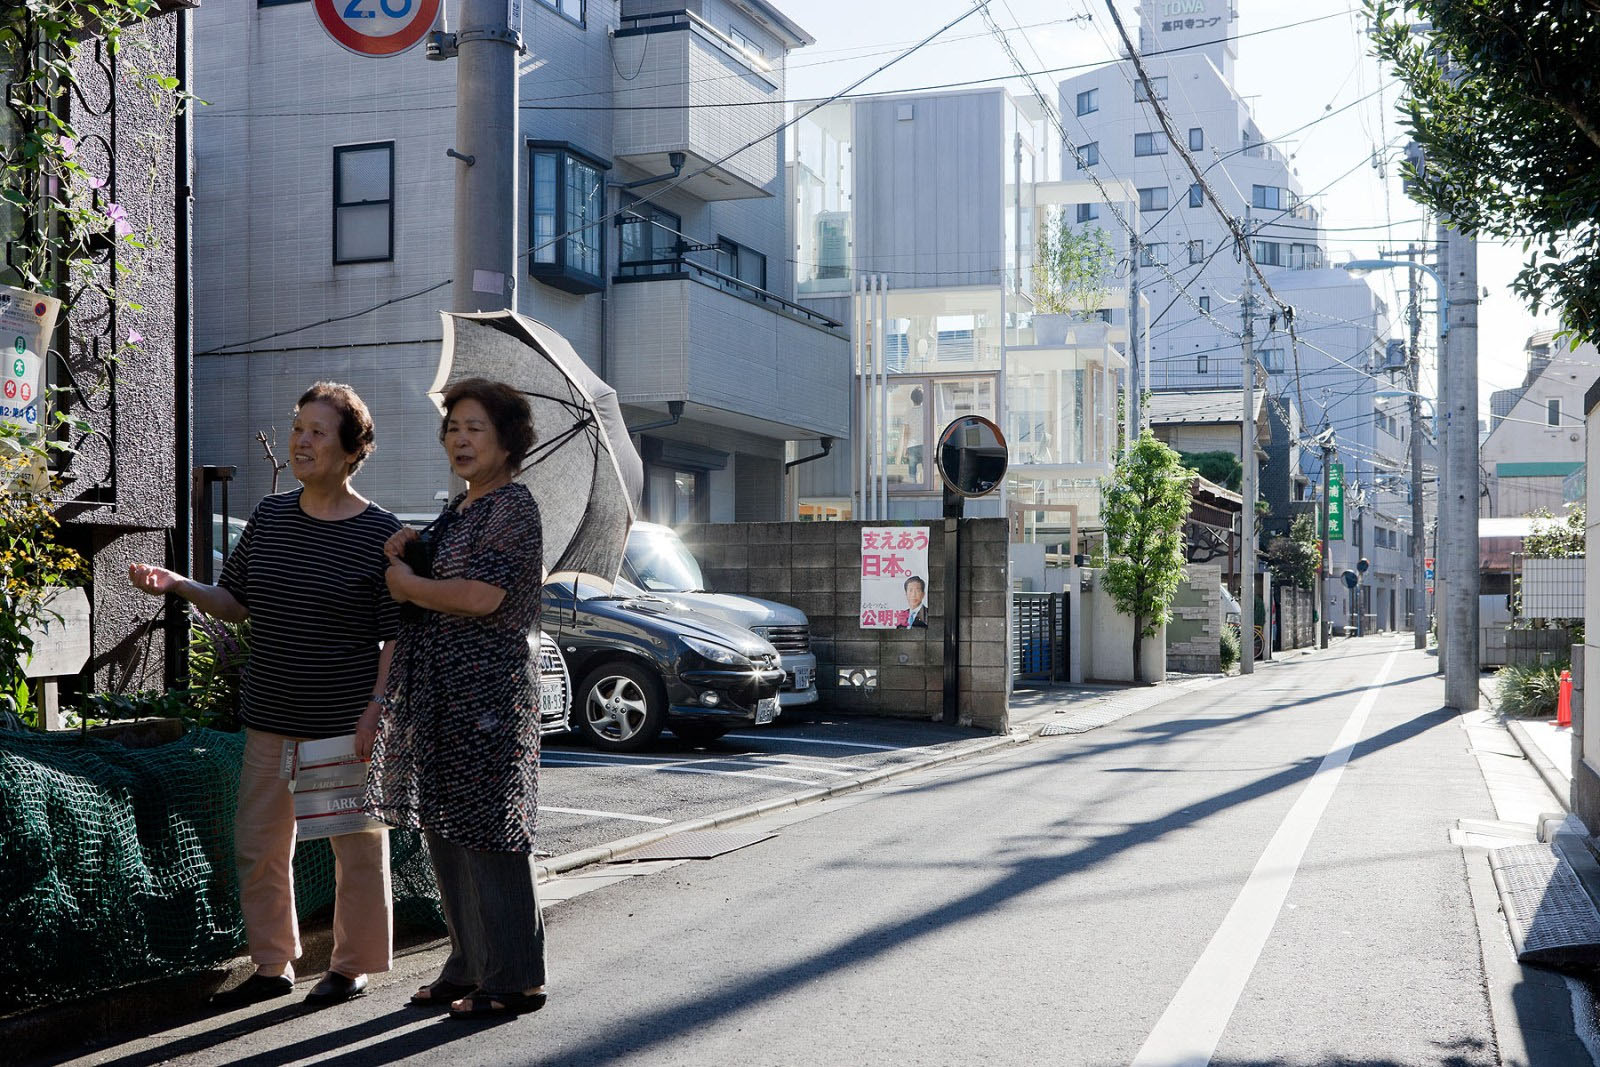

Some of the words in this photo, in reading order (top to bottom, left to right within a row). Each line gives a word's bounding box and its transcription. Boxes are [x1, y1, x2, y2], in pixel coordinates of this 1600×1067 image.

[1161, 16, 1221, 32] 高円寺コープ
[15, 360, 24, 372] 木
[6, 382, 15, 394] 火
[863, 531, 928, 550] 支えあう
[863, 553, 912, 578] 日本。
[862, 609, 910, 627] 公明党
[327, 797, 358, 811] LARK
